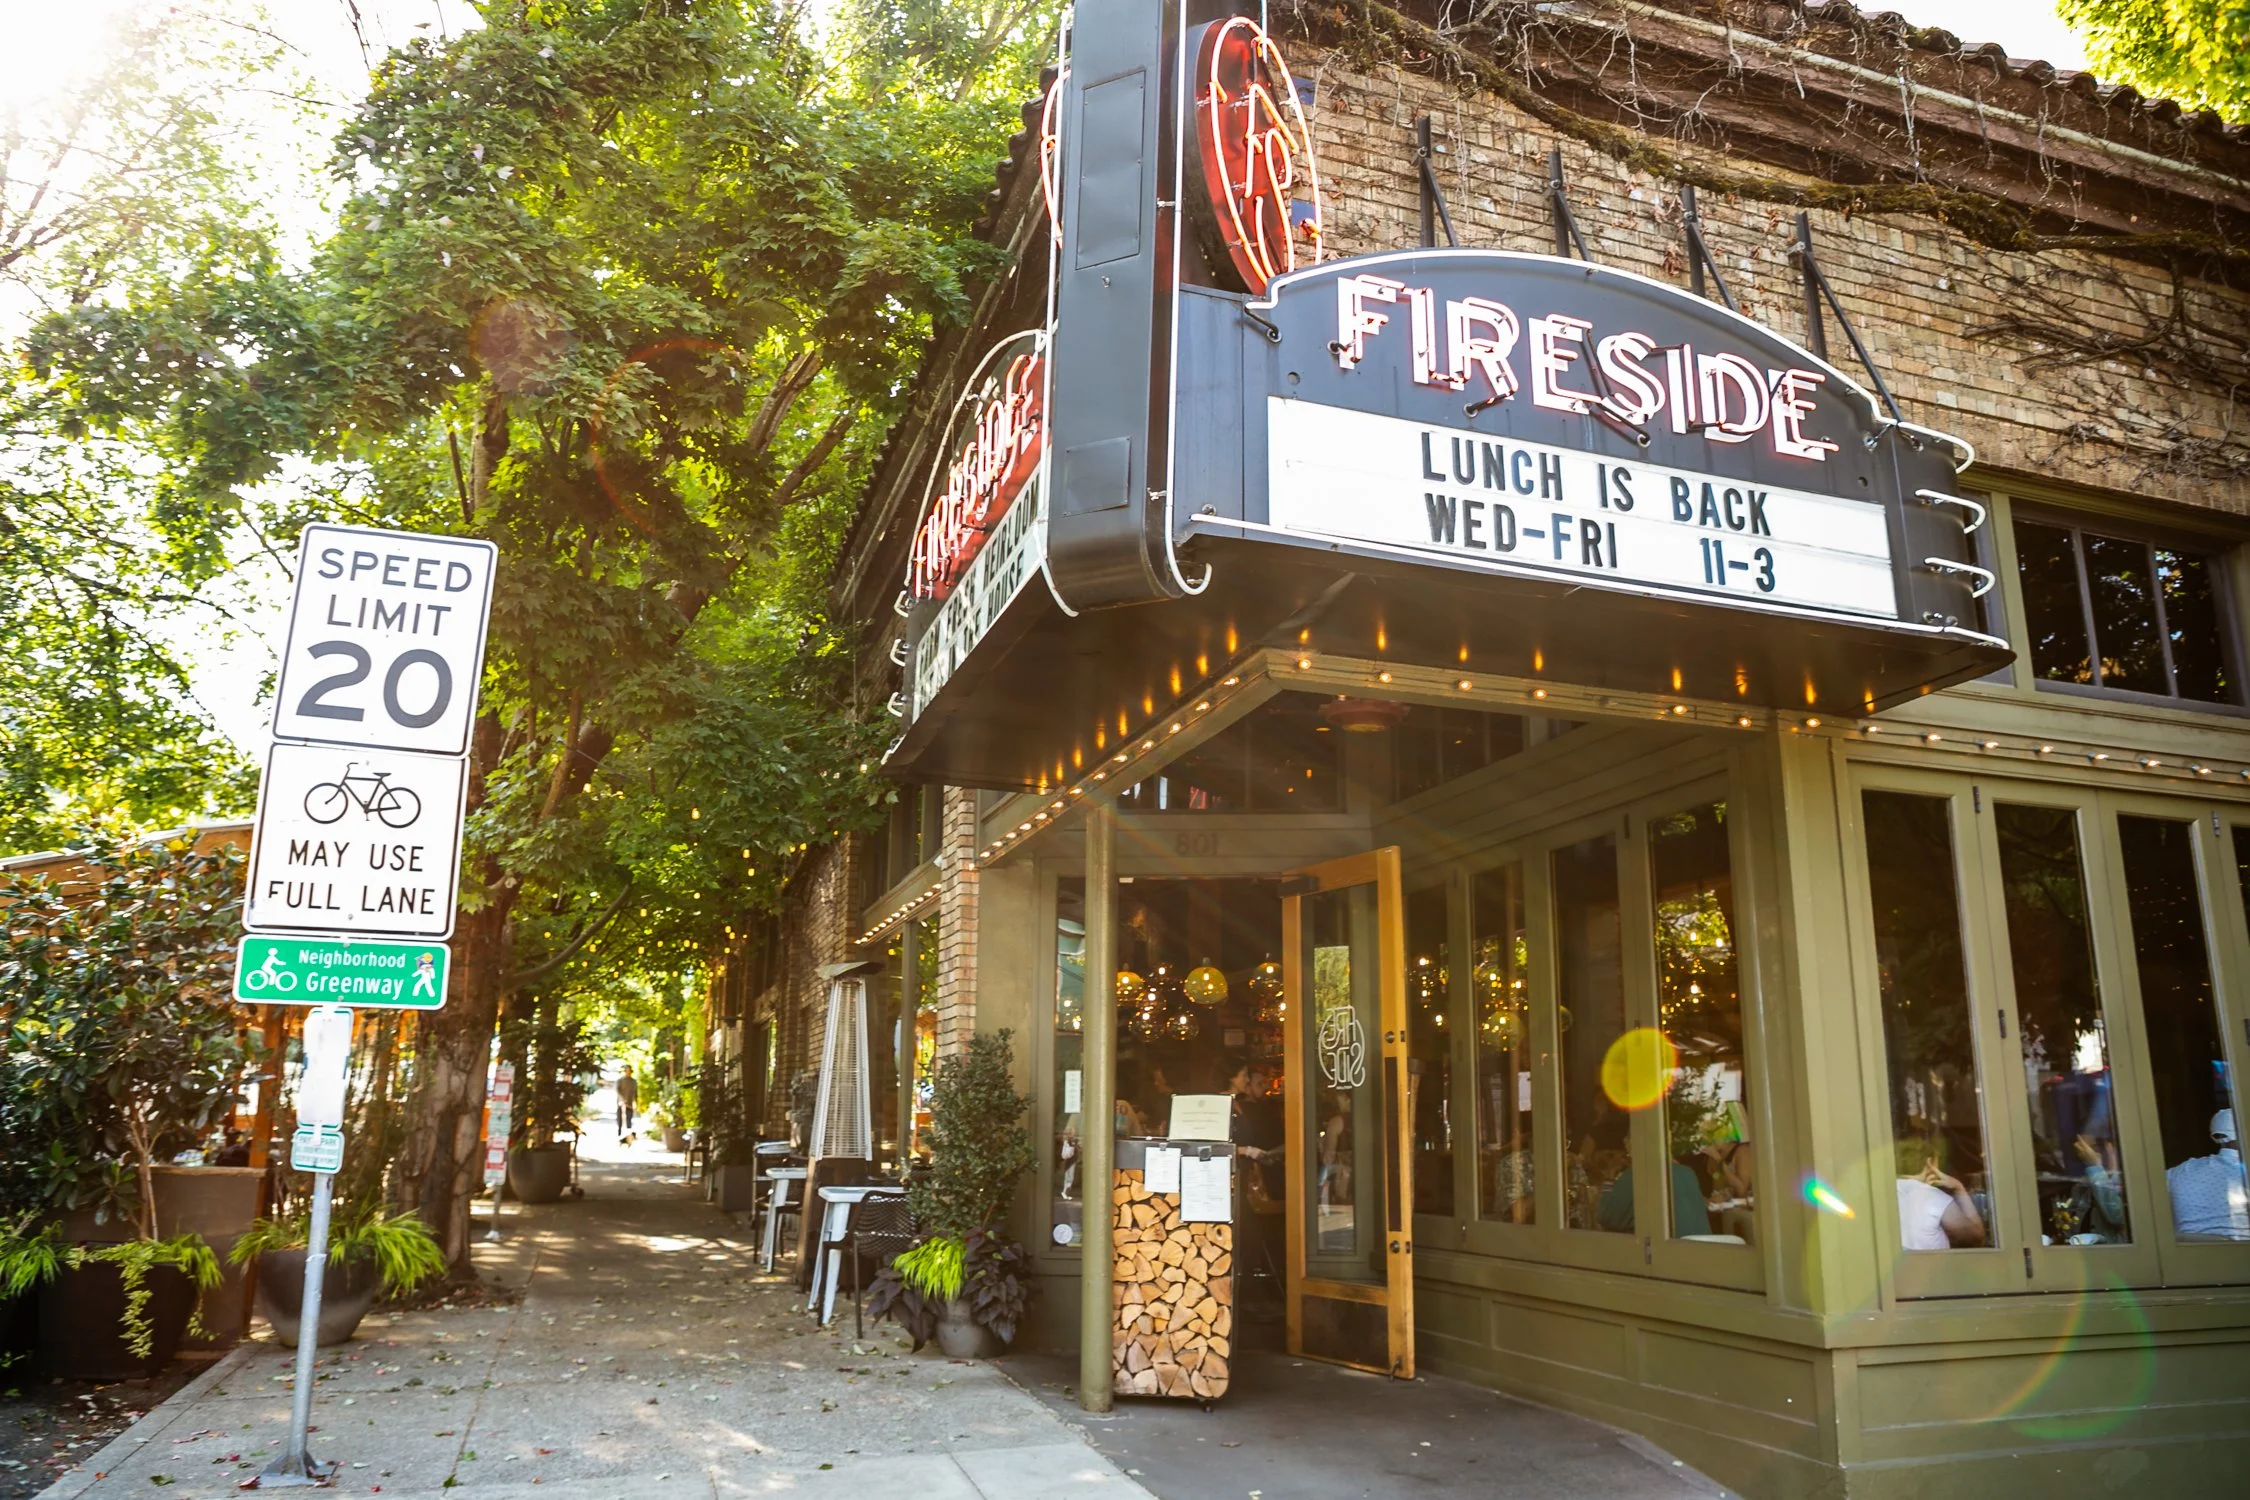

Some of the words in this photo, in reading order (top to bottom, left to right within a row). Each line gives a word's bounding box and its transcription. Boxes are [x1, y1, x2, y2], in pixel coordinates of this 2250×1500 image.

[1336, 274, 1839, 462] FIRESIDE
[914, 354, 1038, 601] FIRESIDE
[1421, 431, 1564, 502] LUNCH
[1598, 462, 1634, 512] IS
[1670, 475, 1771, 536] BACK
[983, 473, 1040, 591] HEIRLOOM
[1424, 492, 1618, 569] WED-FRI
[1699, 536, 1776, 593] 11-3
[318, 548, 472, 593] SPEED
[987, 549, 1025, 629] HOUSE
[326, 594, 452, 637] LIMIT
[296, 640, 453, 729] 20
[288, 839, 350, 868] MAY
[369, 843, 424, 872] USE
[1175, 832, 1218, 857] 801
[268, 880, 341, 910] FULL
[361, 885, 435, 915] LANE
[298, 949, 407, 969] Neighborhood
[306, 971, 405, 1000] Greenway
